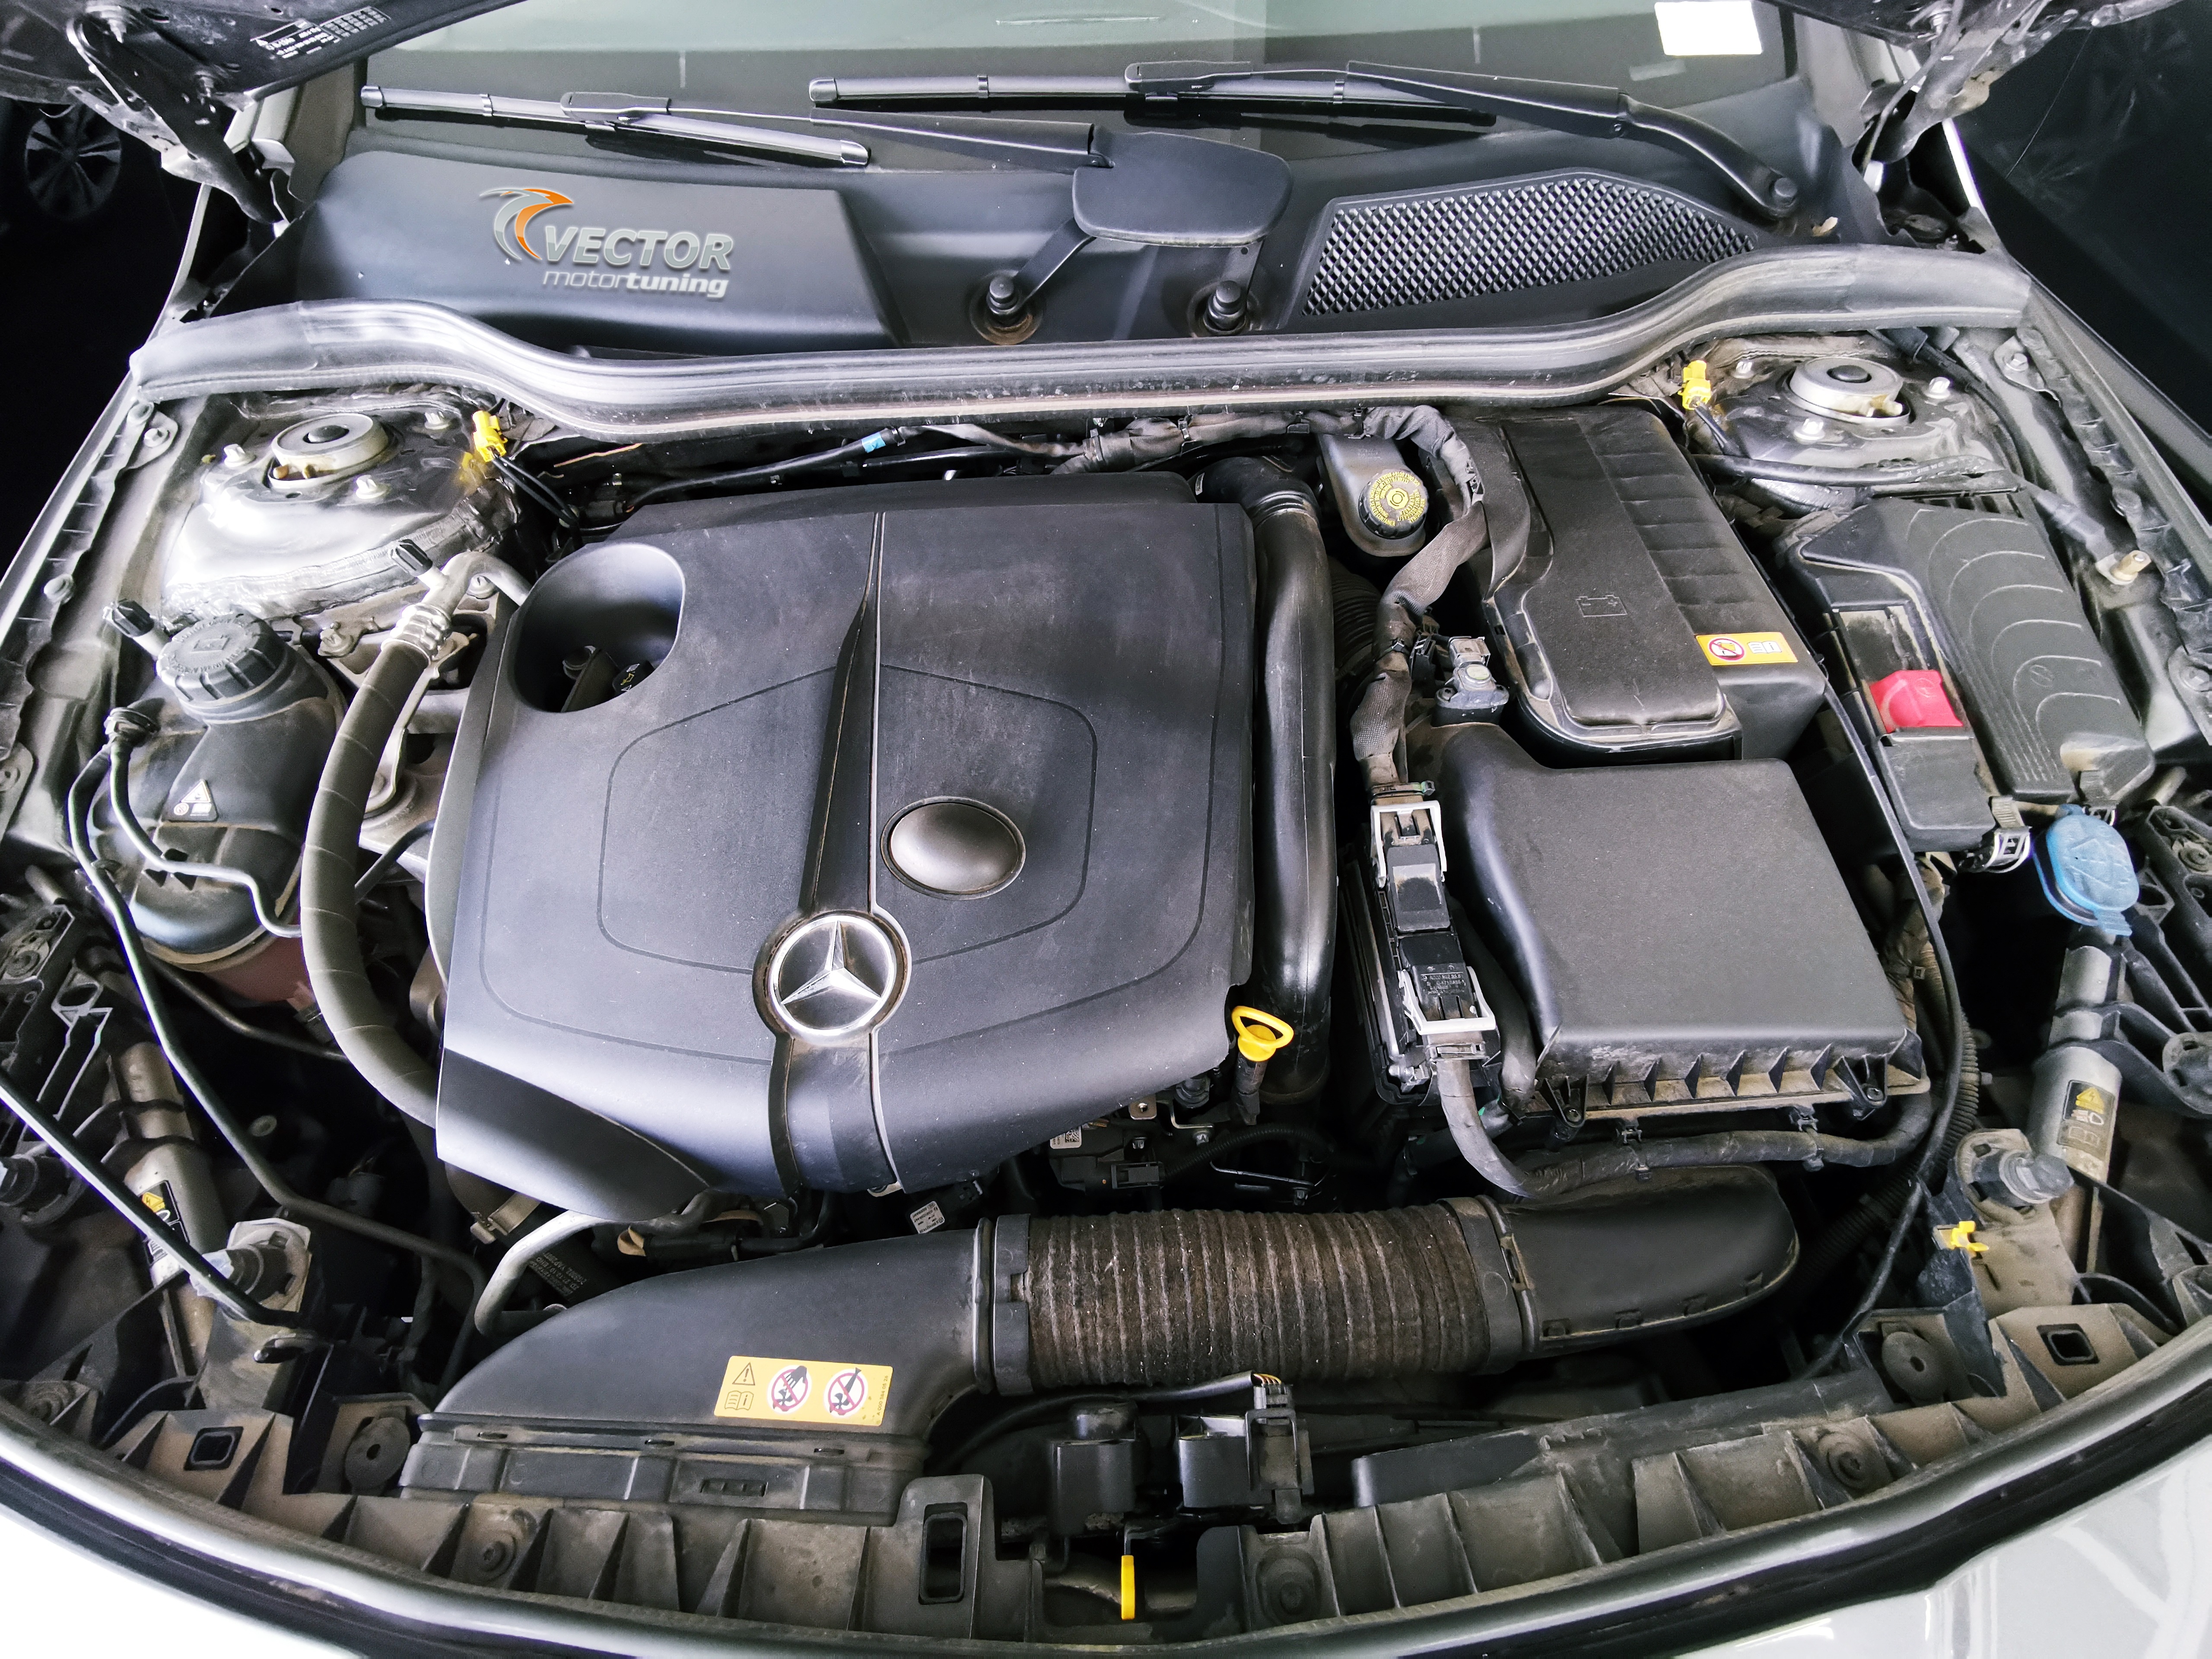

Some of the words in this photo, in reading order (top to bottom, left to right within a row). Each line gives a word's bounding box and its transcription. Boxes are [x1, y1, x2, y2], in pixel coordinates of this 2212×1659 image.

[1379, 472, 1392, 481] BRAKE
[1384, 476, 1397, 484] FILLER
[1404, 473, 1414, 481] ONLY
[1412, 478, 1420, 486] USE
[1372, 478, 1382, 489] FLUID
[1370, 501, 1379, 515] SEALED
[1375, 501, 1389, 518] REMOVING
[1376, 513, 1395, 526] CONTAINER
[1408, 507, 1423, 523] ORIGINAL
